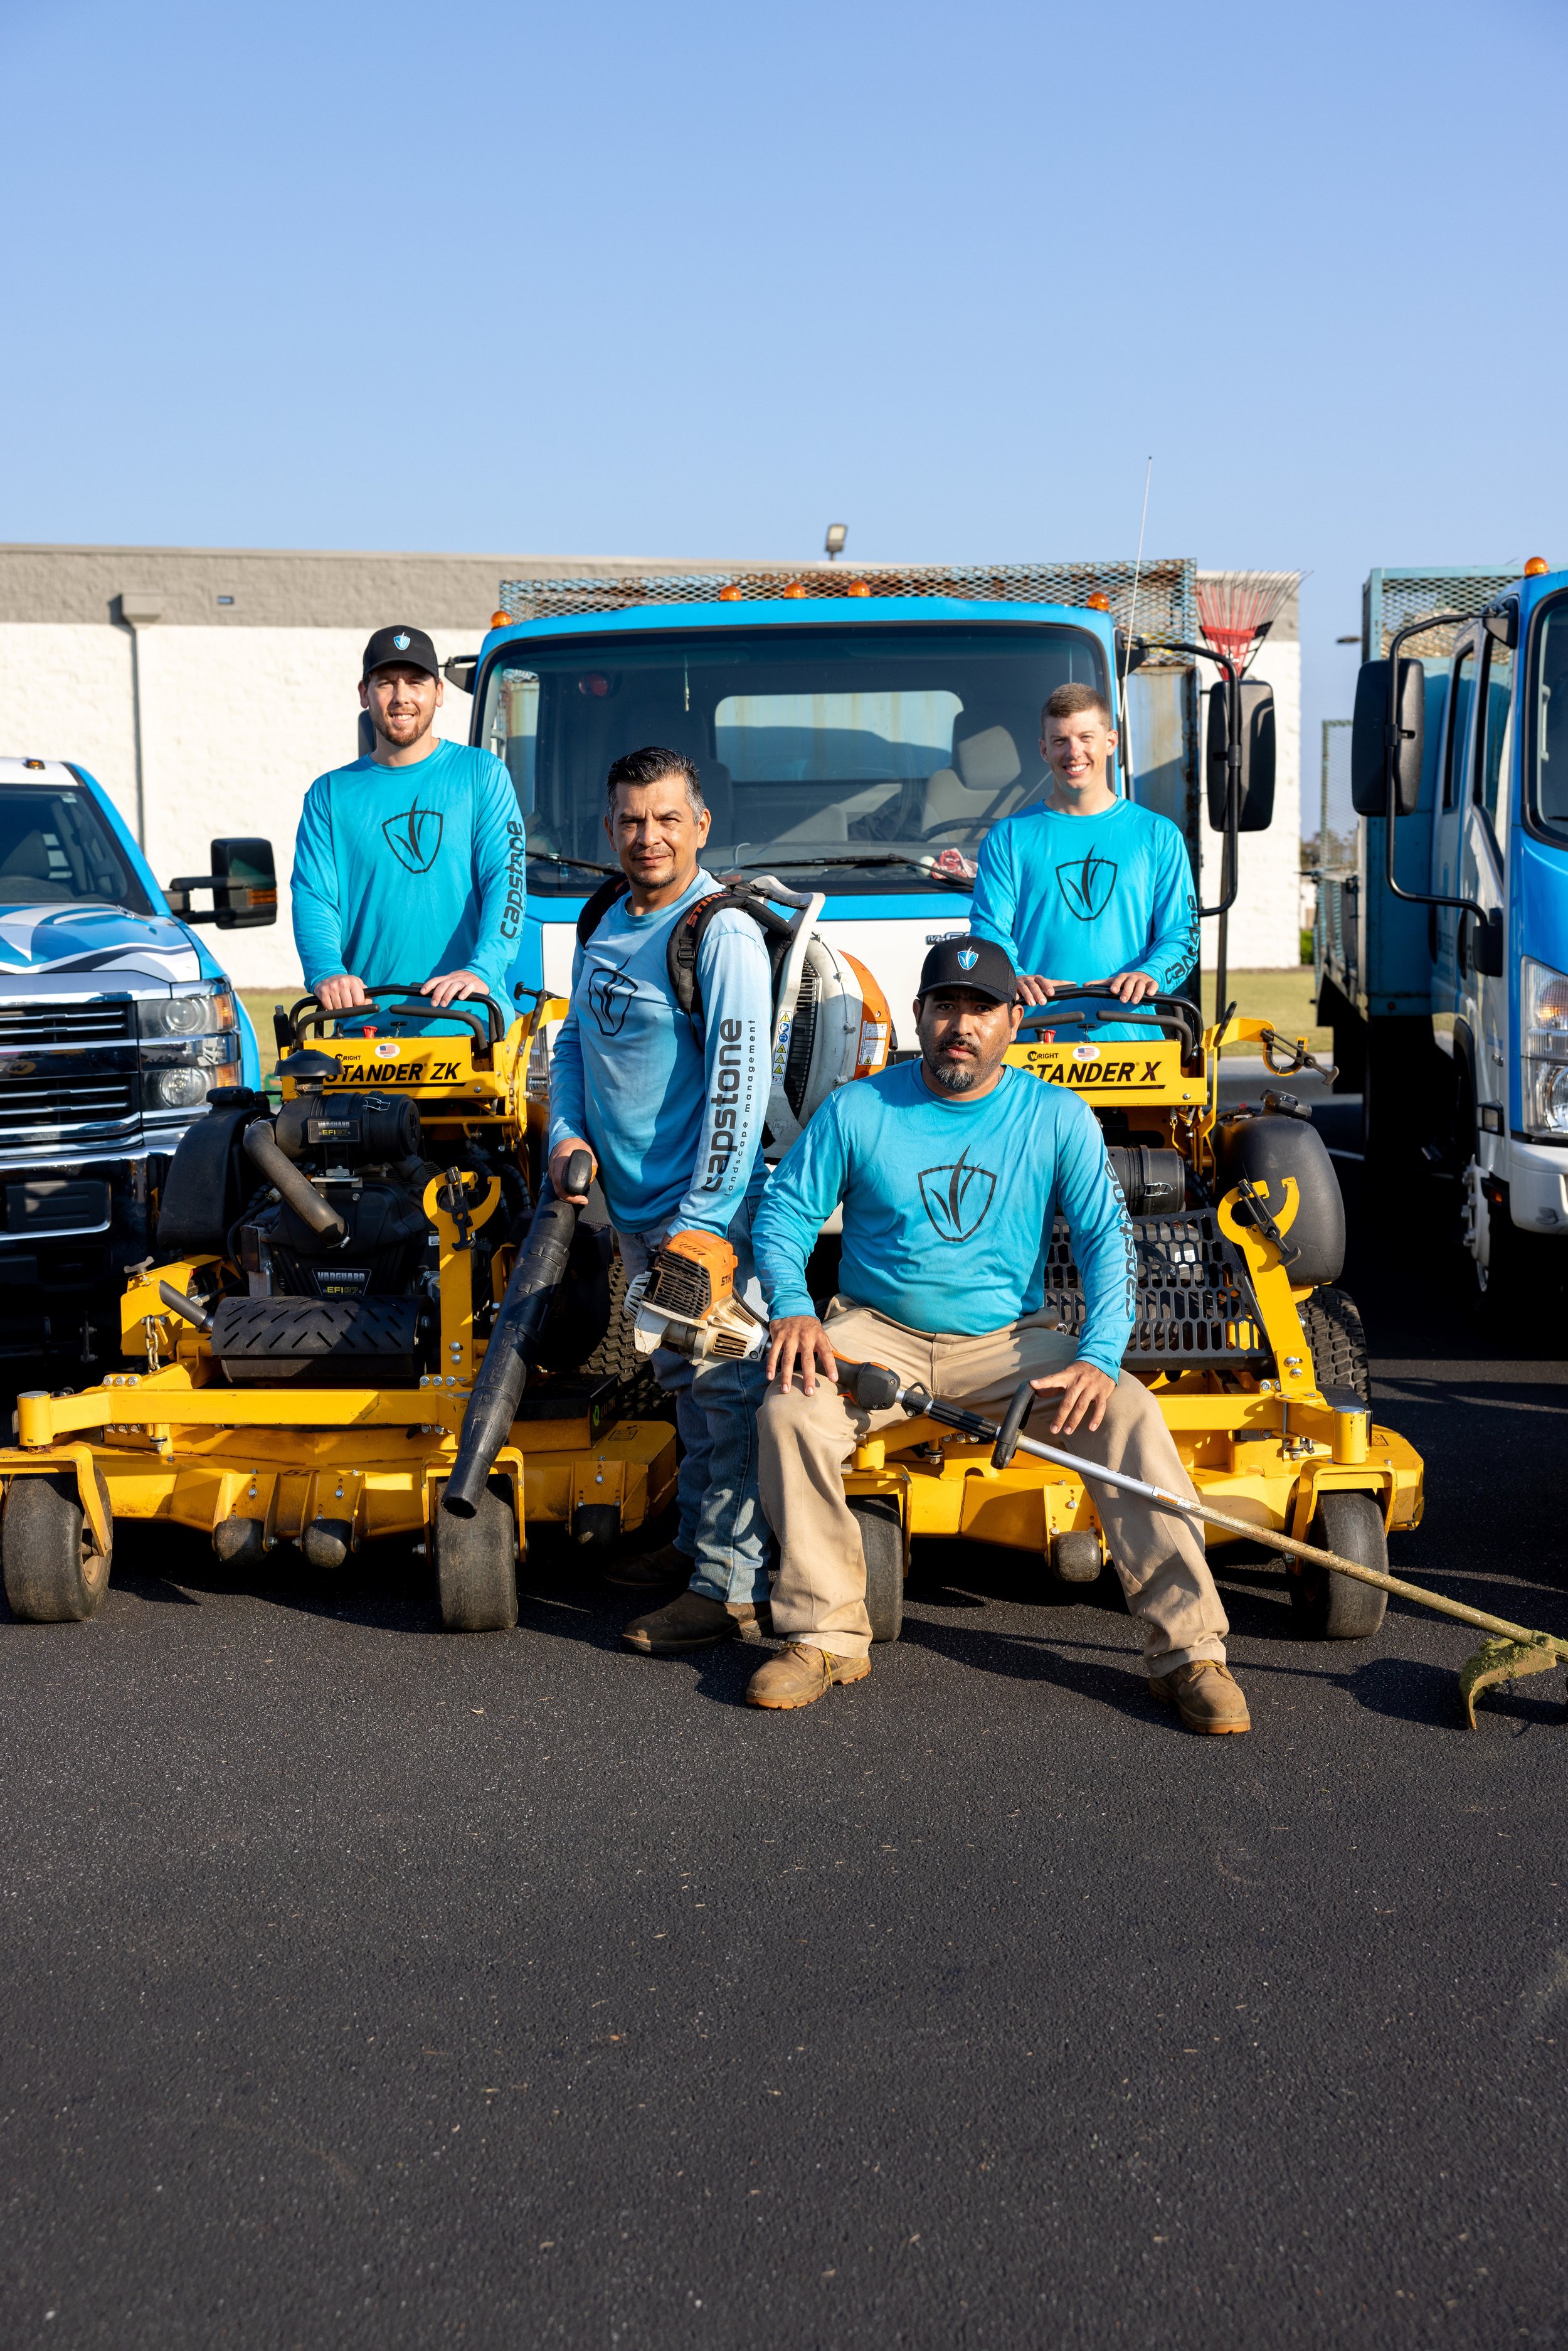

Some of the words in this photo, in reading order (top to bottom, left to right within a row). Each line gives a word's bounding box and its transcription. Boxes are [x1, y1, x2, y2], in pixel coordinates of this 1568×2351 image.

[687, 893, 731, 928] STIHL
[1027, 1051, 1059, 1061] WRIGHT
[430, 1062, 462, 1080] ZK
[1139, 1061, 1162, 1081] X
[701, 1018, 743, 1192] capstone
[724, 1122, 748, 1196] landscape
[744, 1019, 756, 1113] management
[317, 1271, 365, 1282] VANGUARD
